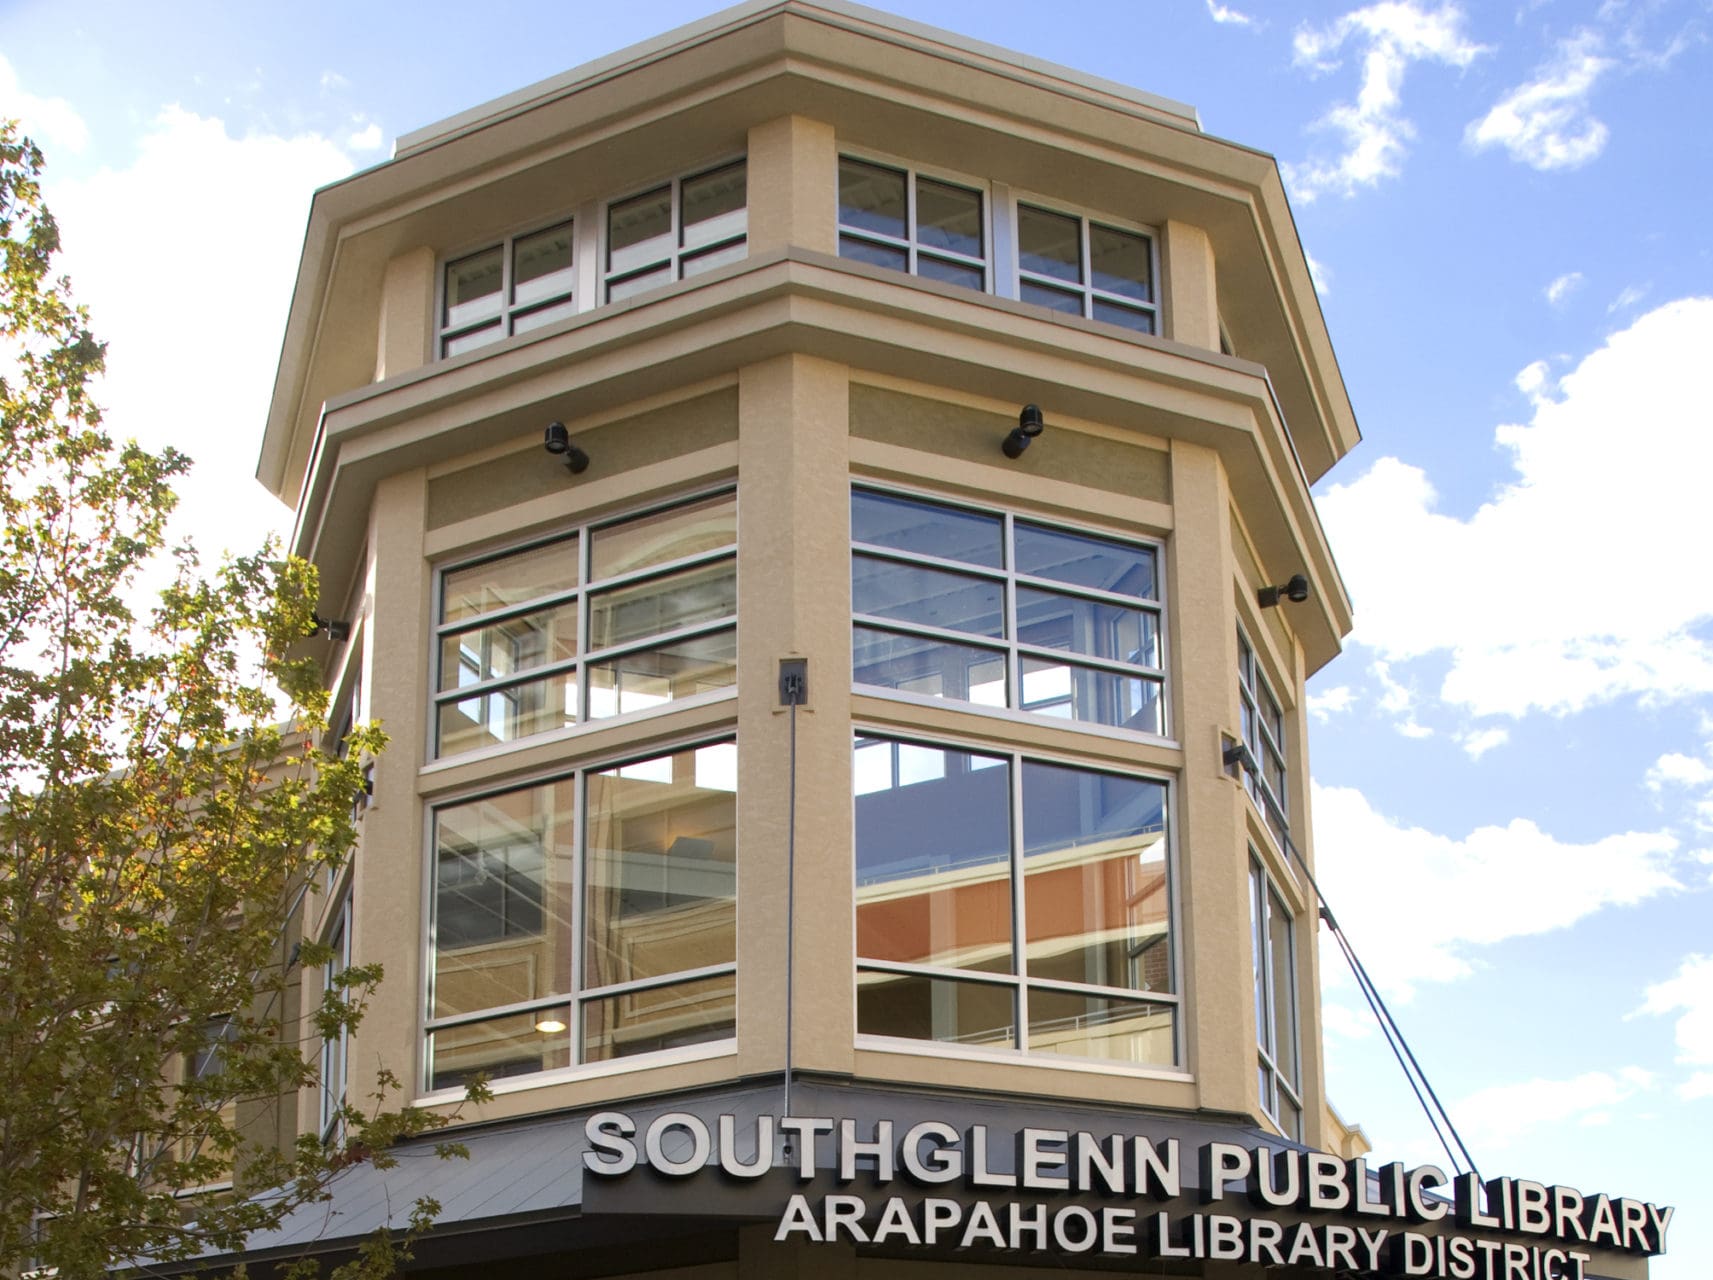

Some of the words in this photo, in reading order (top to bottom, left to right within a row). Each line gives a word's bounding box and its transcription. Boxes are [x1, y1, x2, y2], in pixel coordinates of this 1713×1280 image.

[582, 1111, 1181, 1198] SOUTHGLENN
[1208, 1141, 1450, 1222] PUBLIC
[1466, 1171, 1675, 1255] LIBRARY
[773, 1194, 1138, 1254] ARAPAHOE
[1158, 1211, 1389, 1271] LIBRARY
